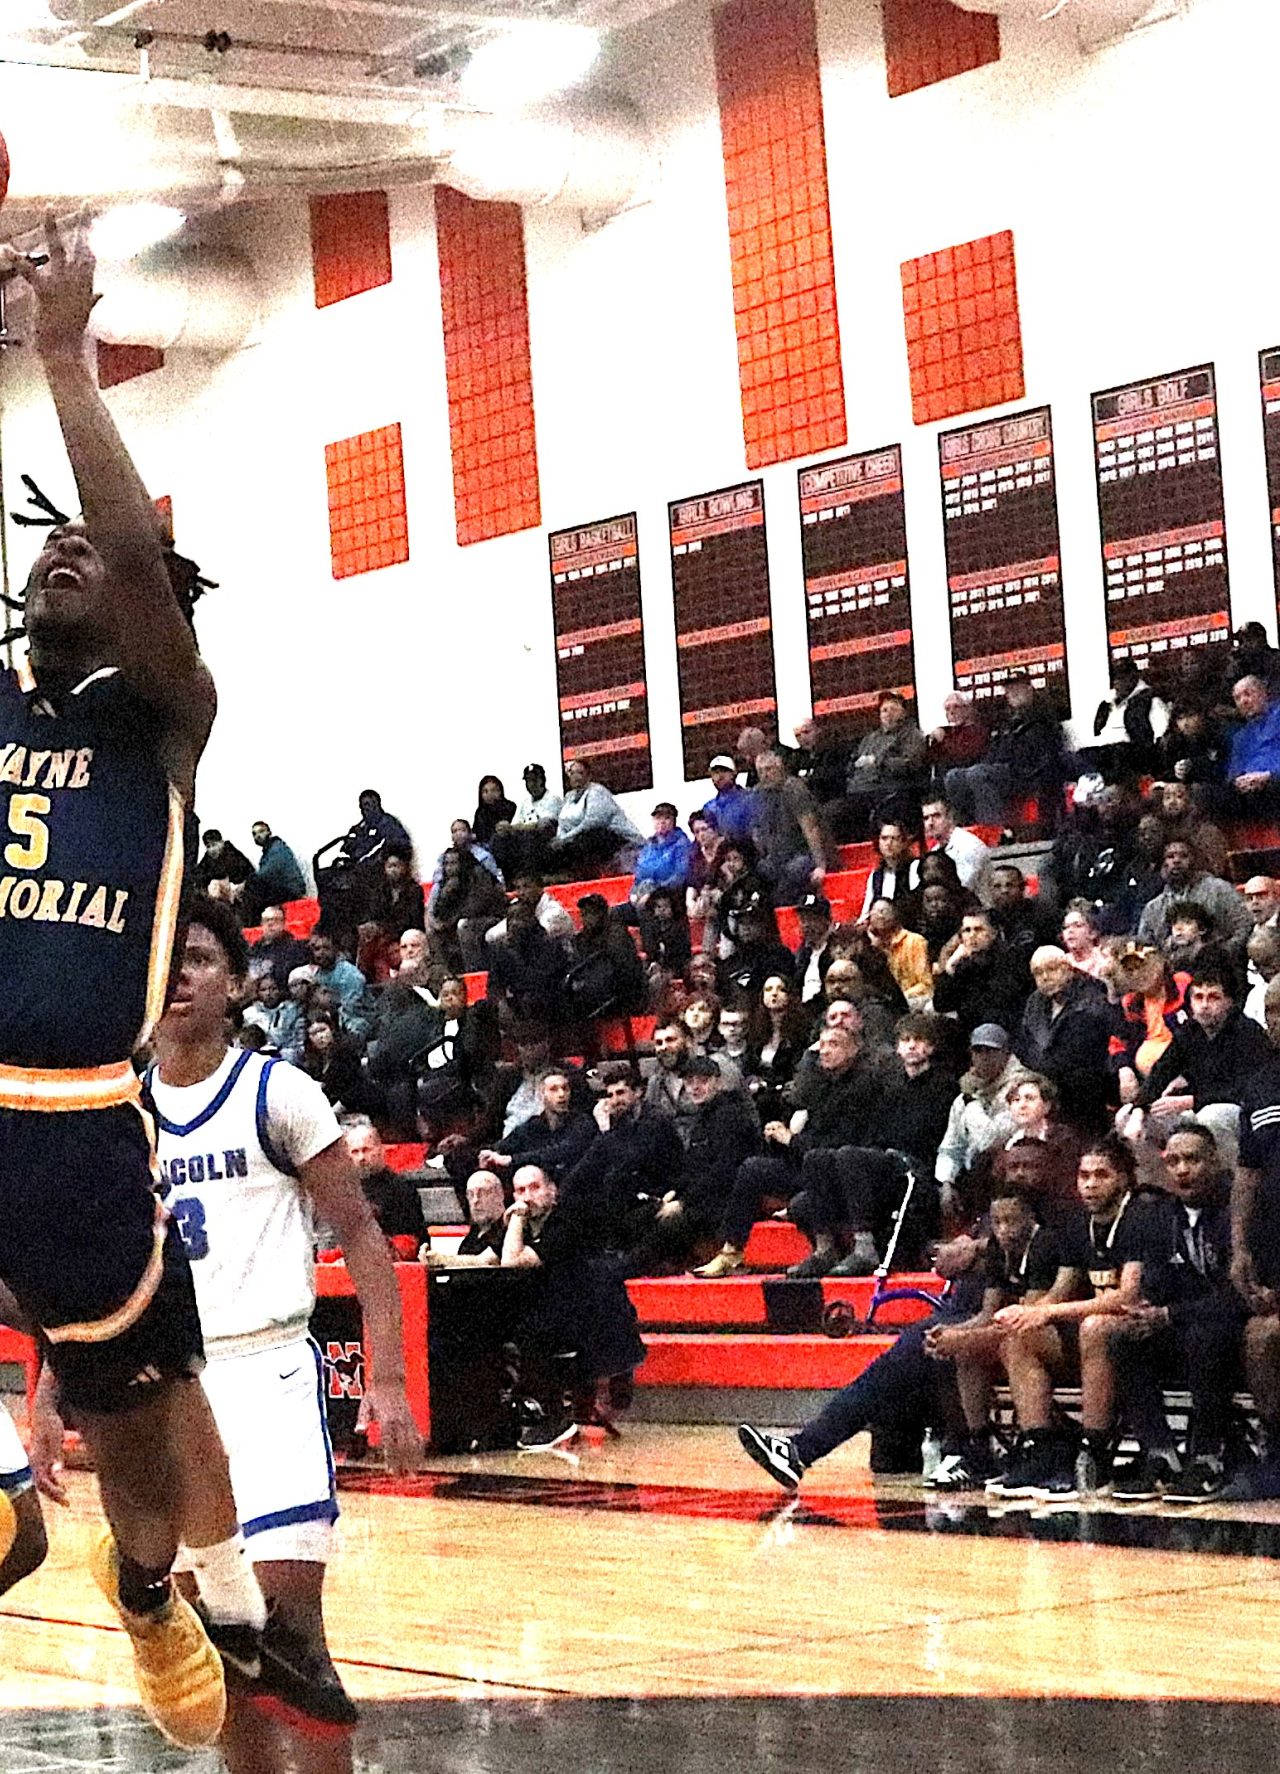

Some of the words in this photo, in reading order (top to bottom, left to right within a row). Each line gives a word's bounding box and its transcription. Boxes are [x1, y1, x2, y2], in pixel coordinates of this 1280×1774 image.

[1118, 388, 1153, 416] GIRLS
[1156, 379, 1189, 405] GOLF
[580, 522, 633, 550] BASKETBALL
[3, 793, 51, 871] 5
